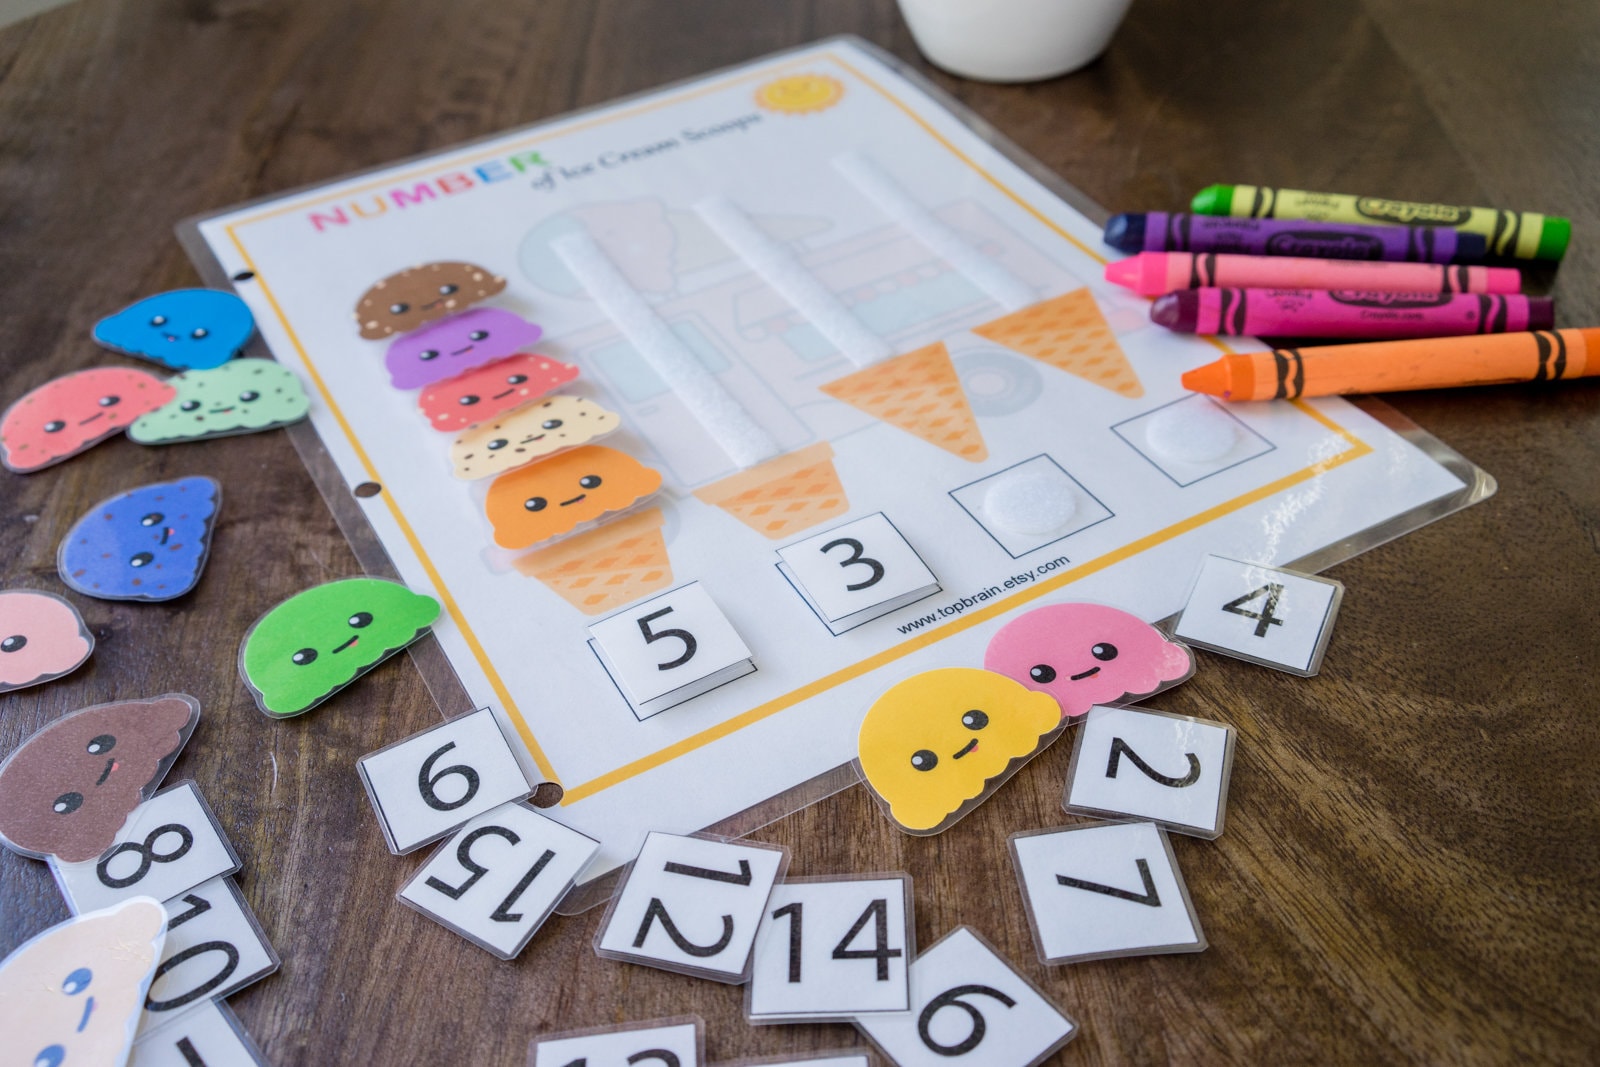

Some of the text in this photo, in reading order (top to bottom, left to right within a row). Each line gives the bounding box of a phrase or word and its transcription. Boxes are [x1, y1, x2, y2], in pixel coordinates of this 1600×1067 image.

[308, 149, 549, 232] NUMBER
[598, 137, 680, 168] Cream
[819, 537, 885, 592] 3
[897, 555, 1081, 635] www.topbrain.etsy.com
[636, 605, 699, 671] 5
[1221, 582, 1285, 638] 4
[1105, 736, 1202, 788] 2
[96, 822, 194, 889] 8
[425, 825, 557, 923] 15
[1055, 858, 1163, 907] 7
[632, 859, 753, 957] 12
[772, 898, 902, 983] 14
